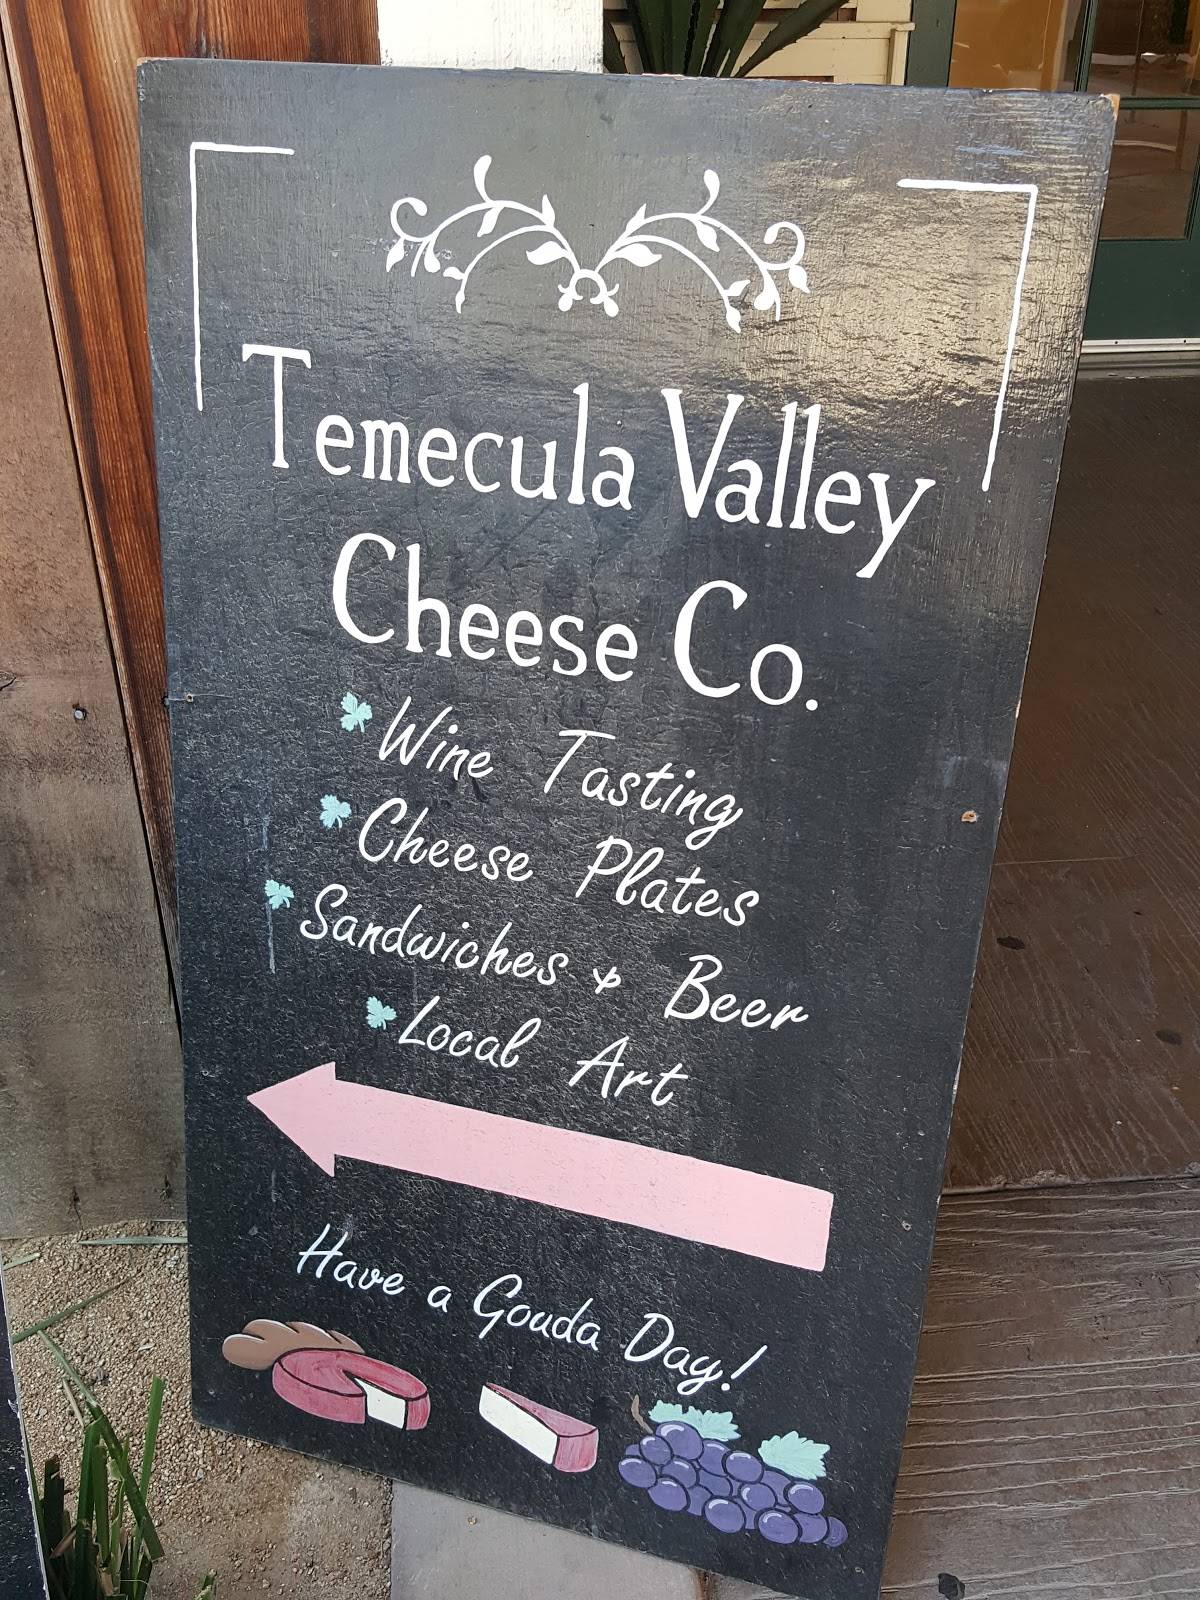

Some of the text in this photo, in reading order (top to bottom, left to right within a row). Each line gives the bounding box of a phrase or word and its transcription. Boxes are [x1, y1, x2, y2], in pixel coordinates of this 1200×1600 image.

[241, 343, 935, 579] Temecula Valley
[332, 532, 819, 711] Cheese Co.
[377, 695, 743, 851] Wine Tasting
[358, 797, 760, 927] Cheese Plates
[299, 883, 809, 1031] Sandwiches & Beer
[398, 995, 689, 1107] Local Art
[296, 1223, 768, 1395] Have a Gouda Day!
